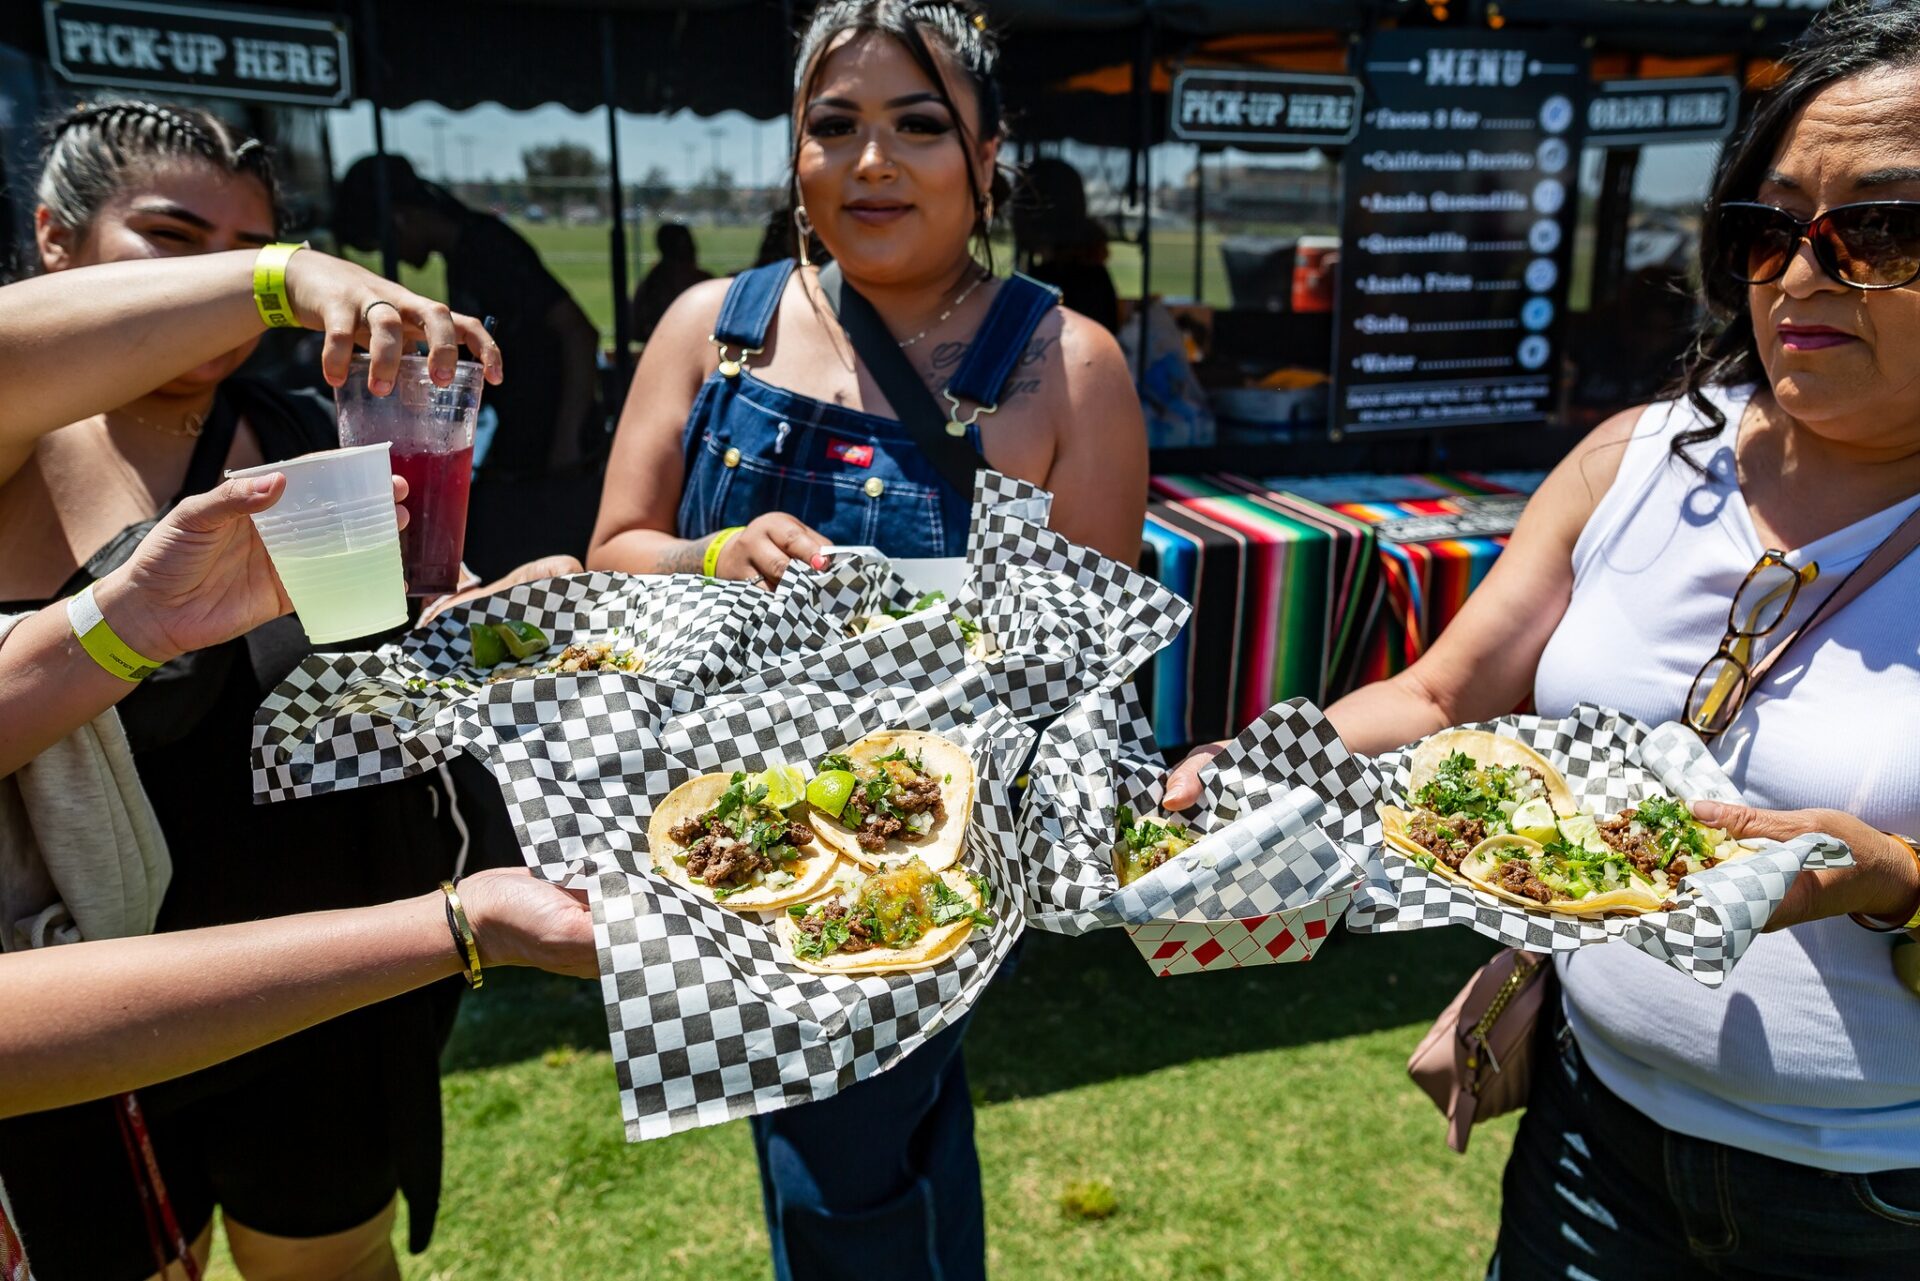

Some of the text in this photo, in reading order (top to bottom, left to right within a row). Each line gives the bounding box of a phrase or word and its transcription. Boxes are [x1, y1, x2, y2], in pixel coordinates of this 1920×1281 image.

[59, 18, 338, 86] PICK-UP HERE
[1426, 48, 1526, 86] MENU
[1182, 90, 1353, 128] PICK-UP HERE
[1450, 107, 1480, 129] for
[1588, 95, 1665, 130] ORDER
[1667, 91, 1727, 125] HERE
[1372, 149, 1465, 171] California
[1466, 149, 1535, 171] Burrito
[1370, 191, 1428, 213] Asada
[1430, 190, 1529, 212] Quesadilla
[1367, 232, 1467, 254] Quesadilla
[1365, 271, 1474, 294] Asada Fries
[1362, 313, 1409, 335] Soda
[1361, 353, 1416, 374] Water
